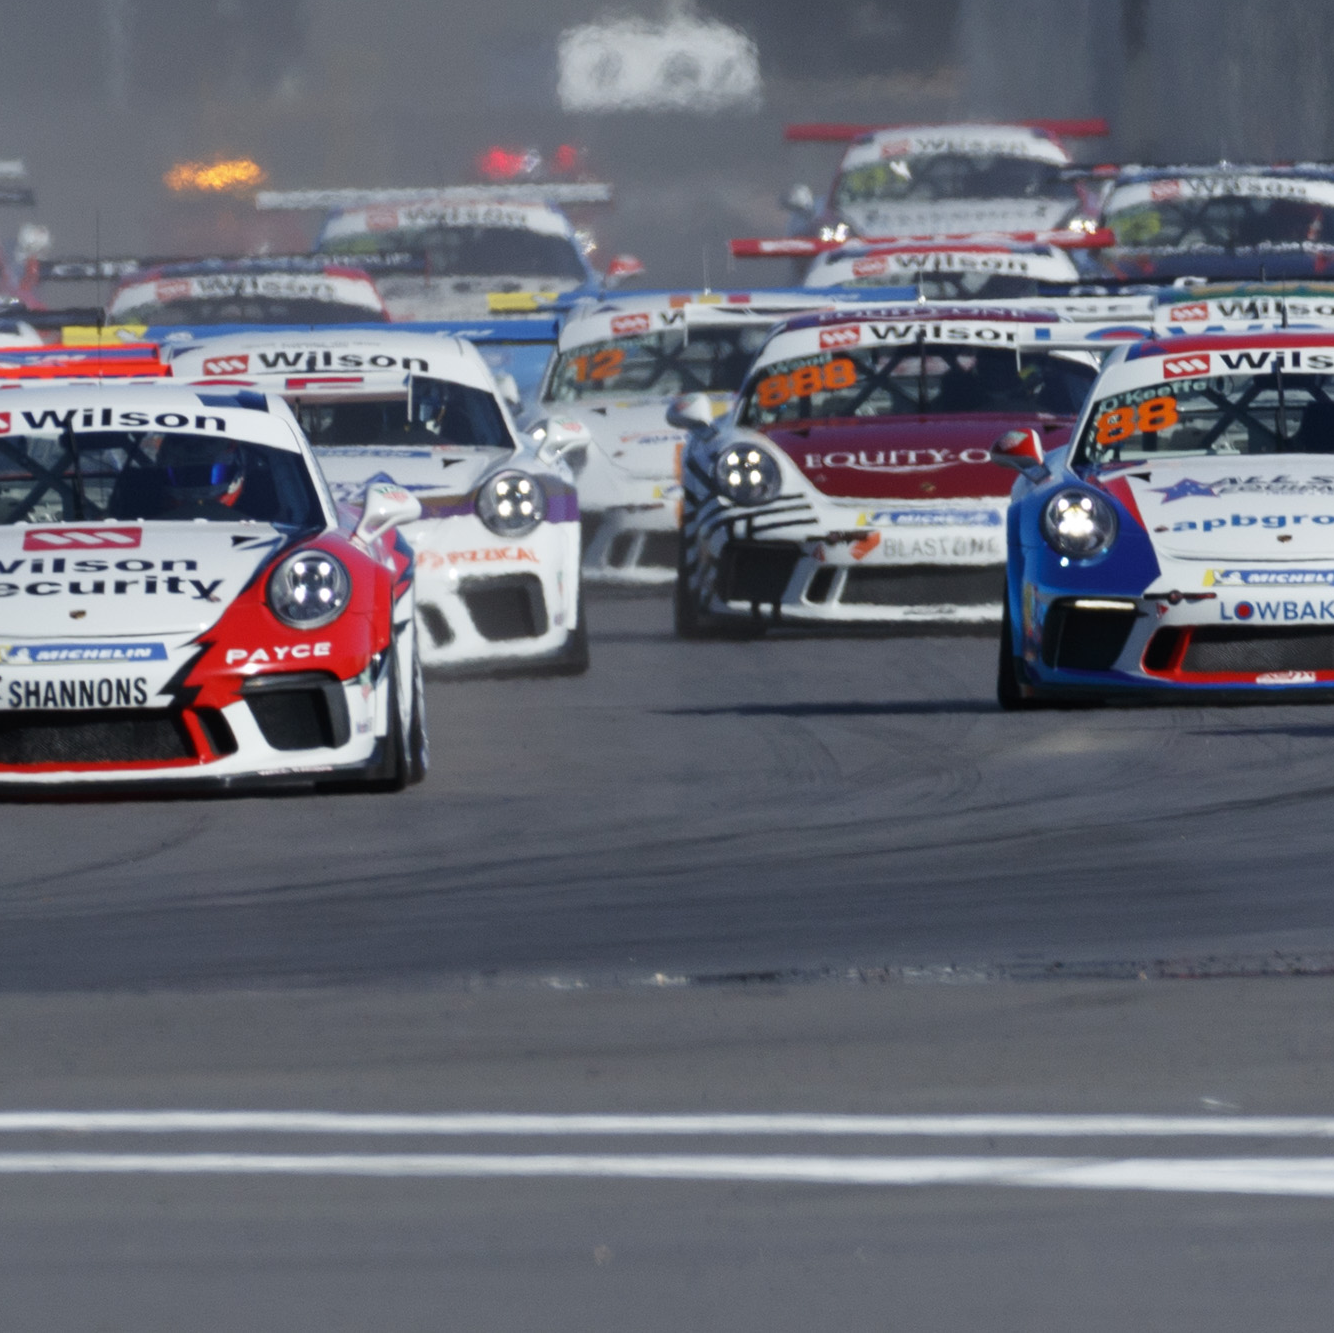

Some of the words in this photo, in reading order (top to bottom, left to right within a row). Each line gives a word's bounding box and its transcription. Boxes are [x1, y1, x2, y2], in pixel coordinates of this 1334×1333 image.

[258, 350, 429, 373] Wilson
[569, 348, 625, 382] 12
[757, 358, 857, 408] 888
[22, 408, 227, 432] Wilson
[1096, 396, 1180, 446] 88
[36, 646, 151, 660] MICHELIN
[226, 641, 332, 665] PAYCE
[8, 677, 148, 709] SHANNONS
